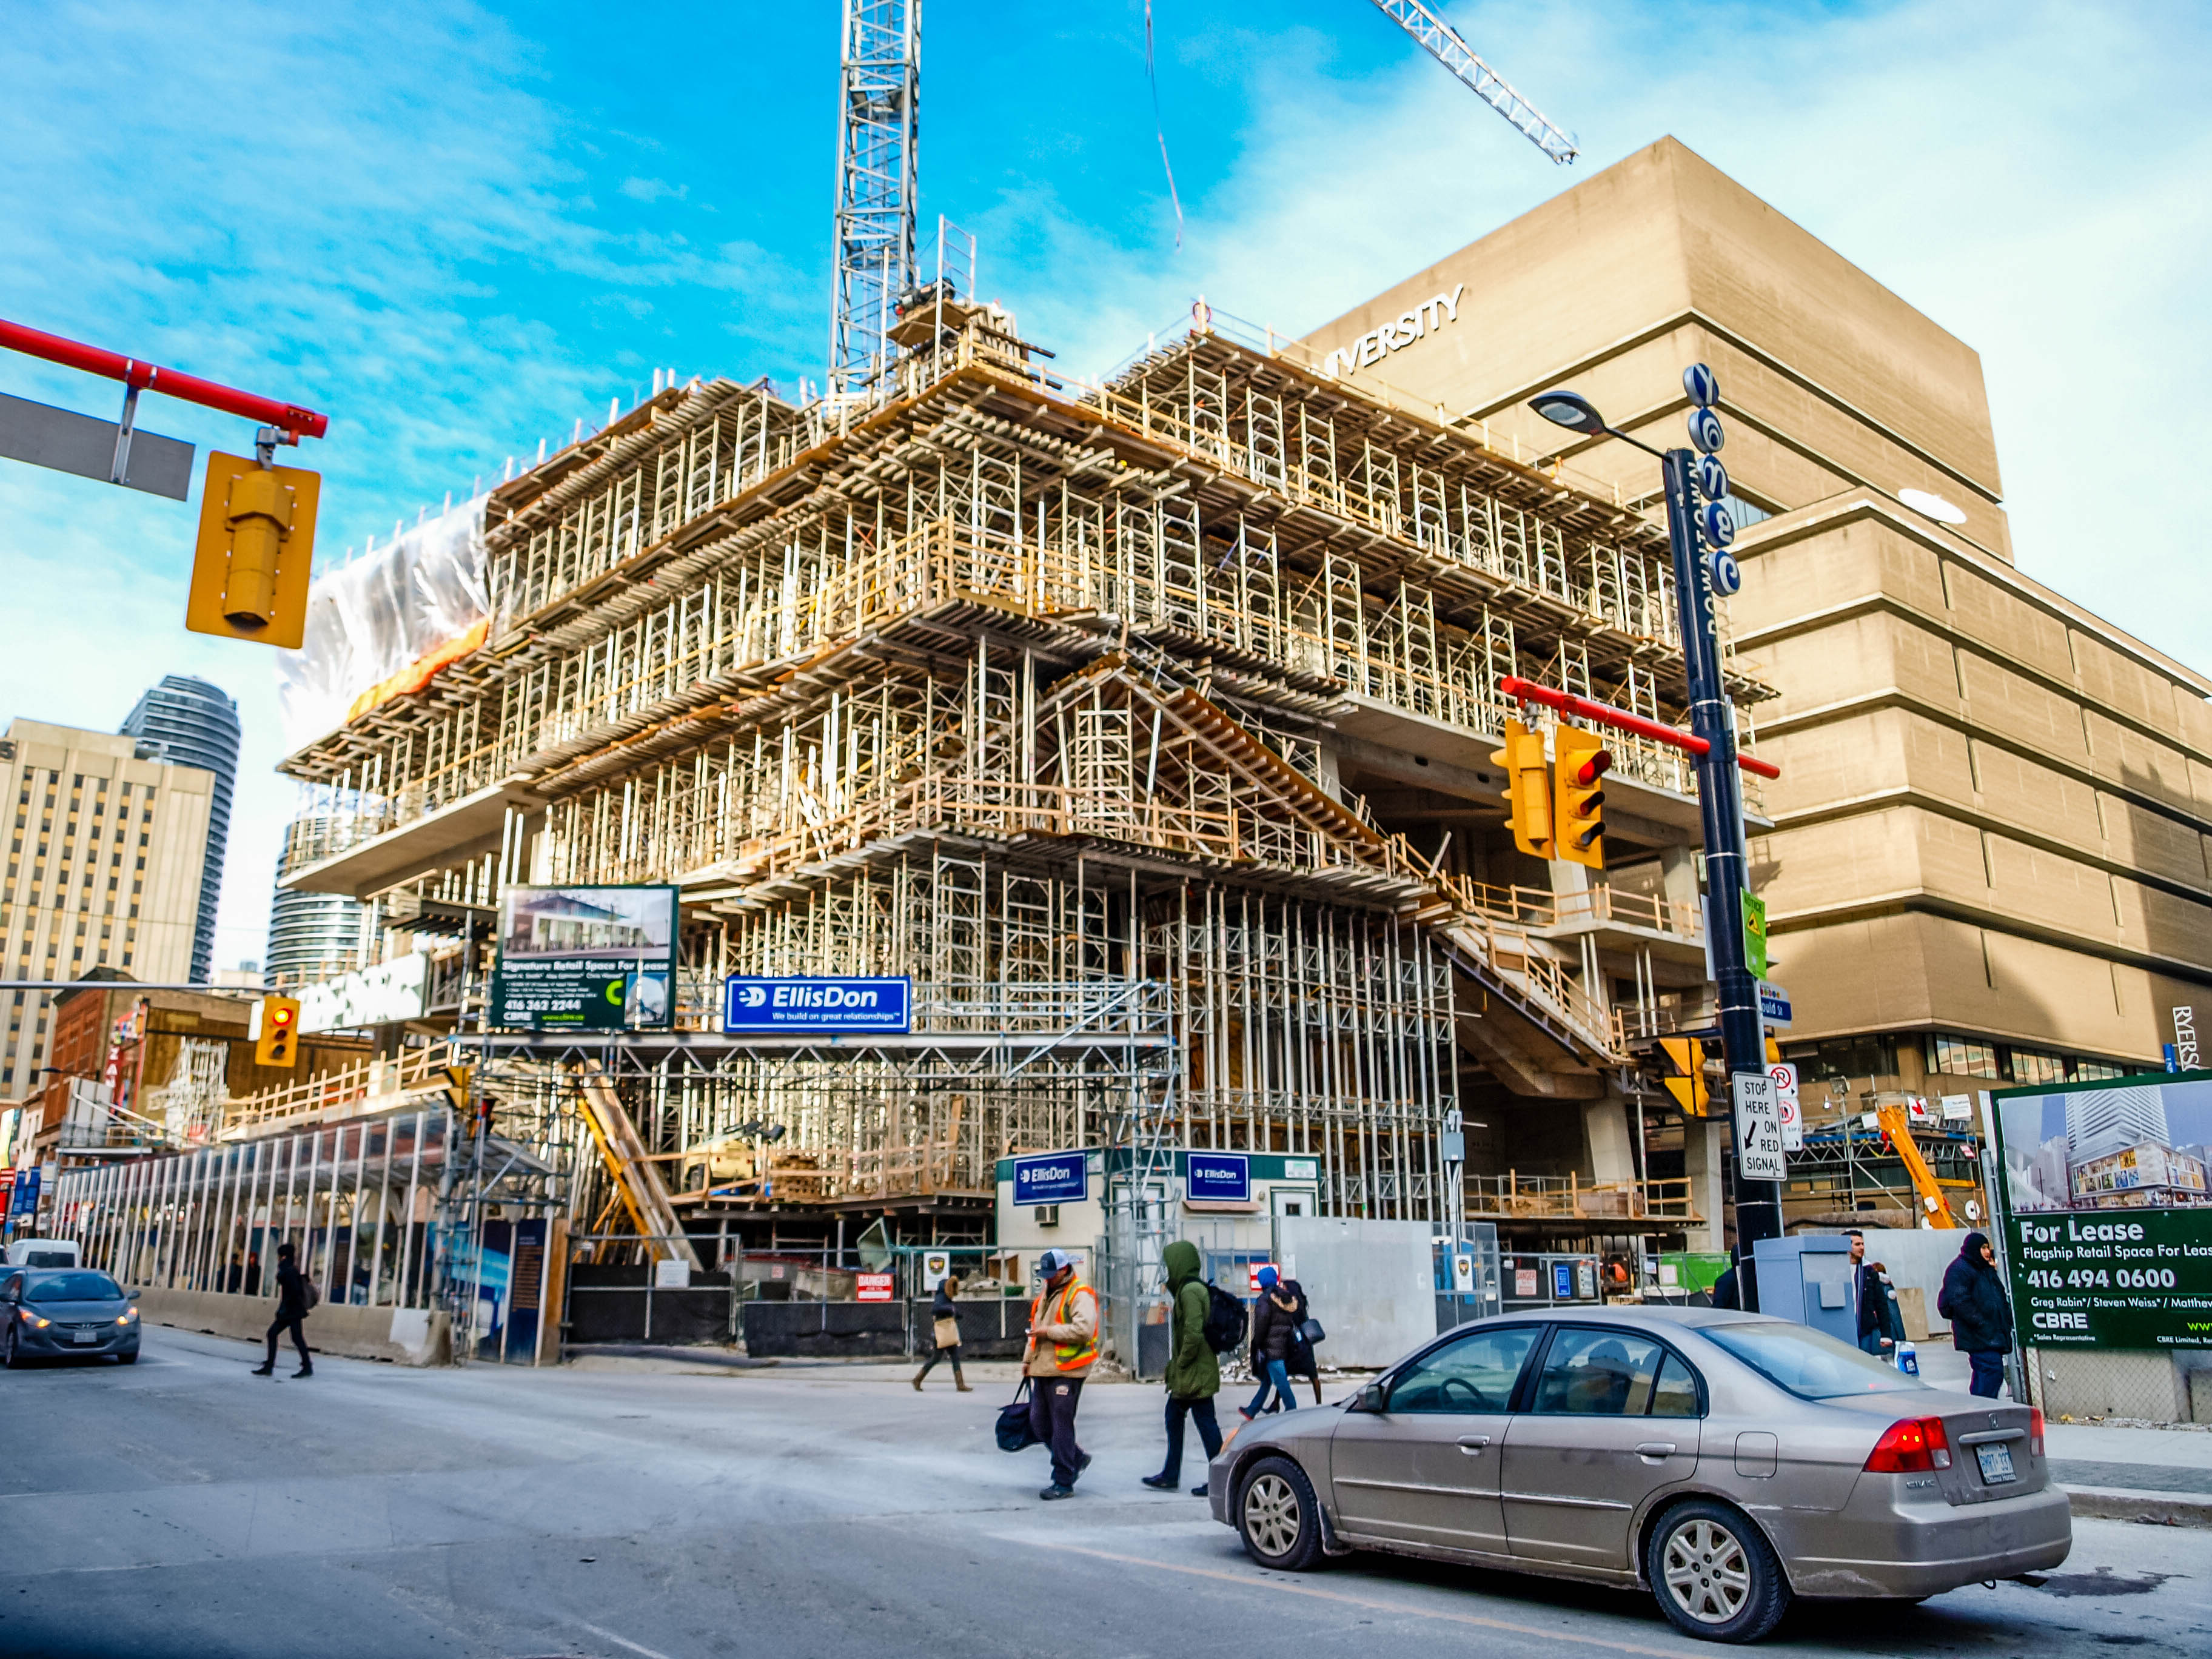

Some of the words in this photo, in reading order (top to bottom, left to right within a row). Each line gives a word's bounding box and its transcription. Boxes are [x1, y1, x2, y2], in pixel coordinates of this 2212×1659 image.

[1324, 283, 1463, 377] IVERSITY
[1687, 461, 1717, 635] DOWNTOWN
[502, 960, 552, 972] Signature
[554, 960, 583, 970] Retail
[585, 961, 616, 971] Space
[618, 961, 635, 970] For
[773, 987, 877, 1007] EllisDon
[504, 999, 525, 1011] 416
[526, 999, 549, 1011] 362
[551, 999, 581, 1011] 2244
[1761, 1000, 1776, 1014] ould
[503, 1011, 532, 1021] CBRE
[786, 1012, 807, 1021] build
[821, 1013, 842, 1022] great
[1744, 1082, 1767, 1096] STOP
[1745, 1101, 1771, 1114] HERE
[1765, 1121, 1777, 1133] ON
[1760, 1139, 1779, 1152] RED
[1747, 1157, 1780, 1171] SIGNAL
[1031, 1167, 1070, 1182] EllisDon
[1204, 1169, 1236, 1179] EllisDon
[2020, 1221, 2060, 1243] For
[2068, 1219, 2144, 1242] Lease
[2023, 1246, 2073, 1261] Flagship
[2076, 1245, 2111, 1258] Retail
[2114, 1245, 2154, 1260] Space
[2157, 1244, 2179, 1257] For
[858, 1275, 891, 1286] DANGER
[1517, 1271, 1536, 1281] DANGER
[2026, 1269, 2063, 1289] 416
[2066, 1269, 2110, 1288] 494
[2116, 1268, 2176, 1288] 0600
[2031, 1296, 2053, 1309] Greg
[2094, 1297, 2125, 1307] Steven
[2031, 1312, 2088, 1329] CBRE
[2187, 1322, 2212, 1331] ww
[1906, 1480, 1935, 1489] CIVIC
